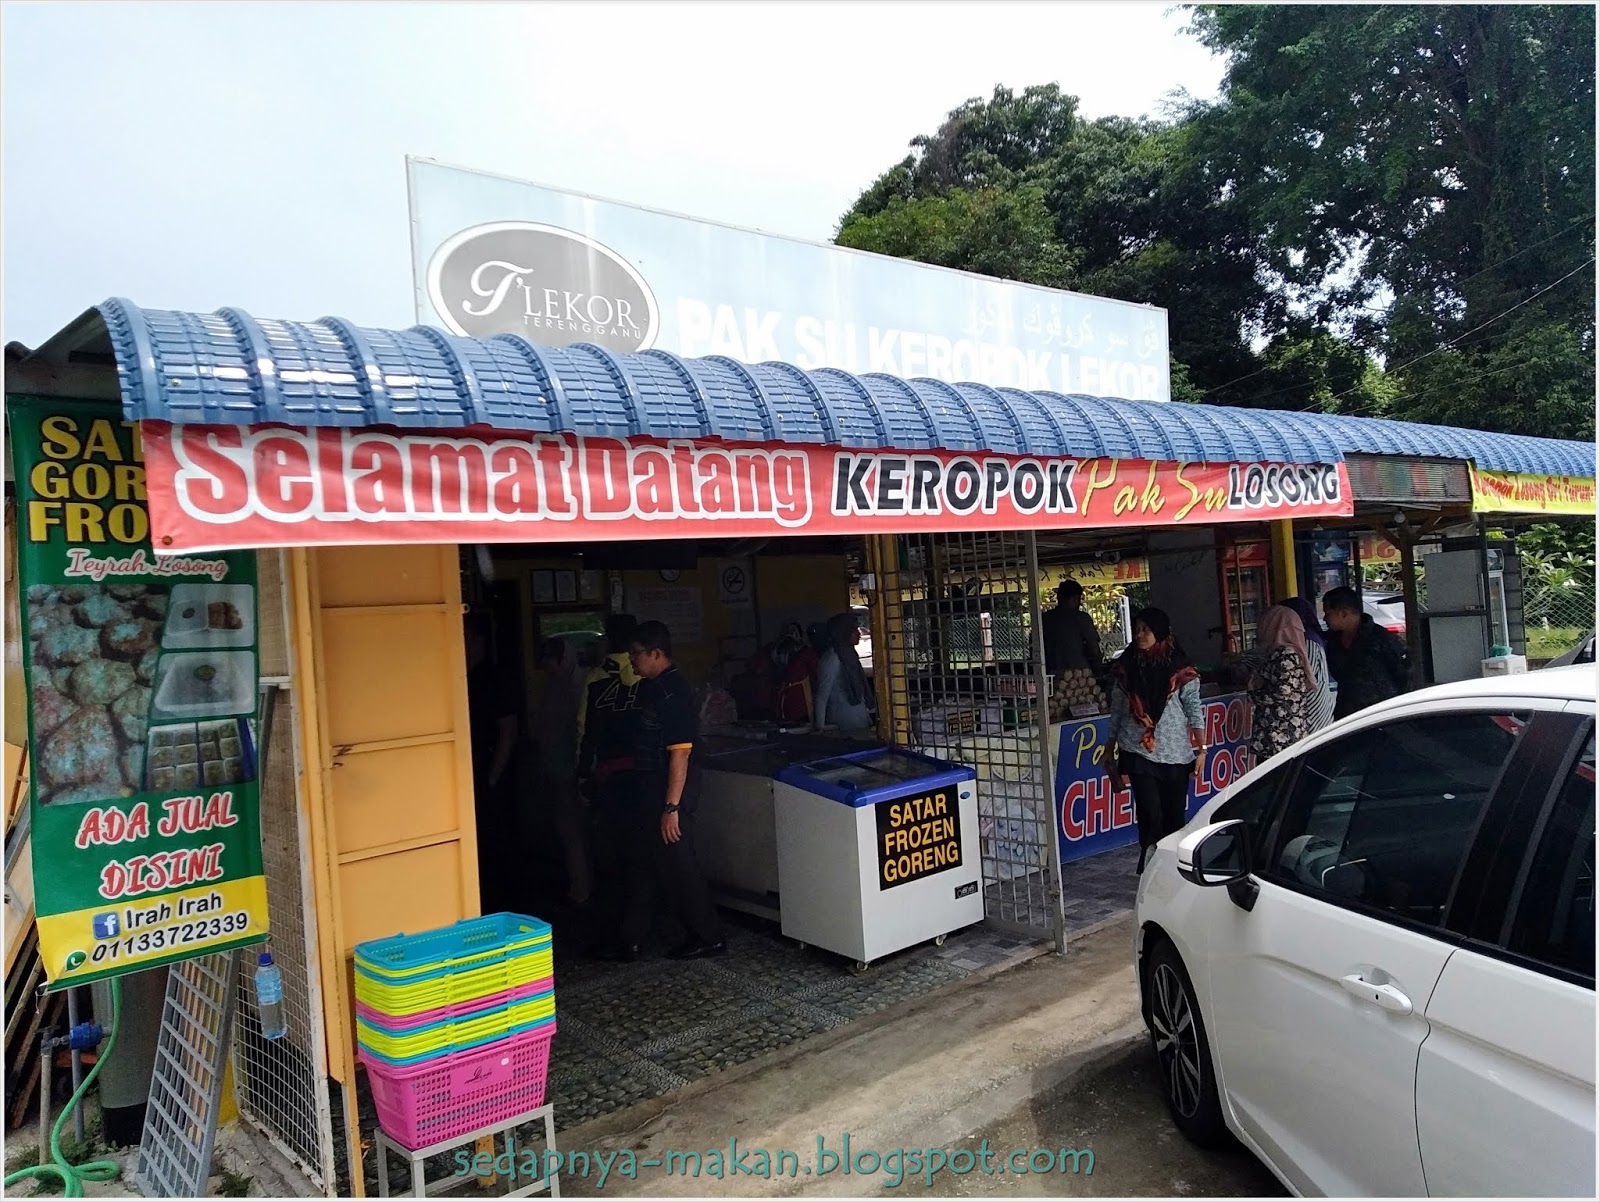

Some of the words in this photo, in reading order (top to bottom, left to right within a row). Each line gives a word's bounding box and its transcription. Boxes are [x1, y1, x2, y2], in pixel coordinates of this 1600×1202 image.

[523, 315, 642, 340] TERENGGANU
[677, 295, 783, 366] PAK
[794, 315, 858, 374] SU
[868, 325, 1052, 392] KEROPOK
[1060, 352, 1160, 400] LEKOR
[171, 424, 578, 524] Selamat
[580, 435, 813, 527] Datang
[831, 451, 1078, 516] KEROPOK
[1077, 458, 1166, 517] Pak
[1173, 459, 1228, 521] Su
[1227, 463, 1341, 510] LOSONG
[75, 802, 150, 849] ADA
[157, 791, 239, 836] JUAL
[889, 793, 947, 828] SATAR
[884, 817, 955, 856] FROZEN
[98, 843, 225, 899] DISINI
[883, 841, 959, 883] GORENG
[126, 906, 171, 930] Irah
[178, 893, 222, 917] Irah
[91, 912, 248, 962] 01133722339
